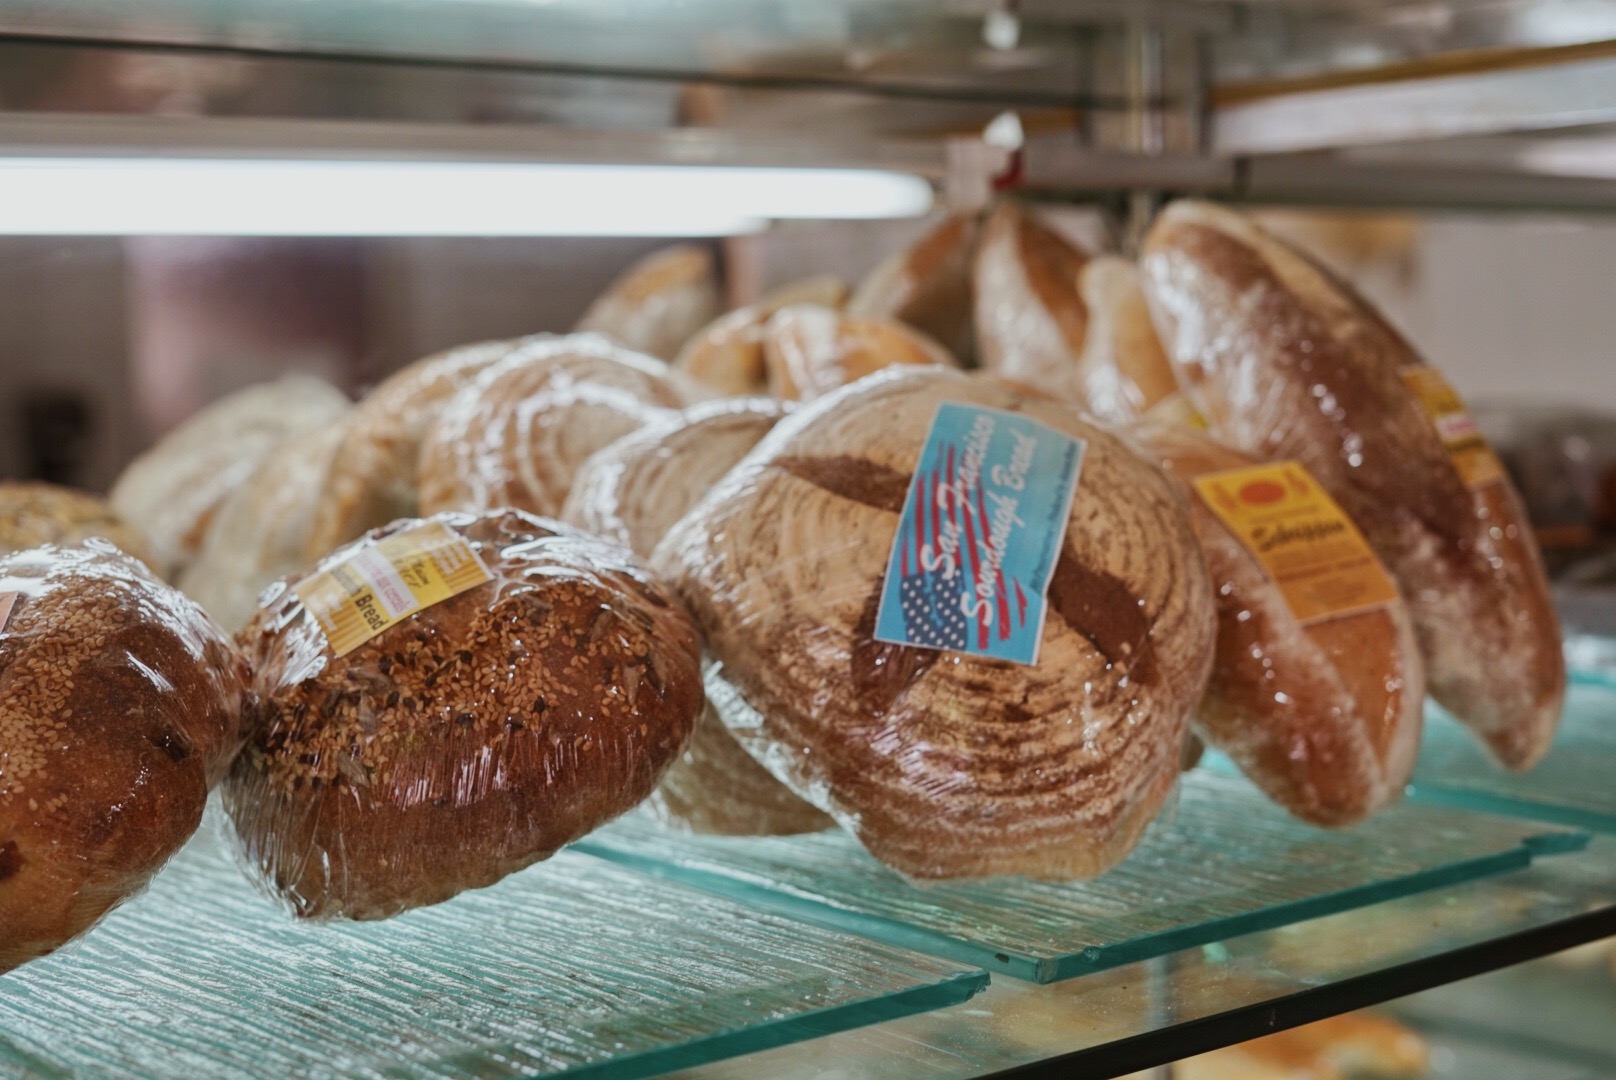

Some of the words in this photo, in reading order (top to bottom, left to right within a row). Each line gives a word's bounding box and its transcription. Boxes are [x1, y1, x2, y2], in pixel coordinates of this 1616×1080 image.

[935, 414, 996, 515] Francisco
[991, 429, 1037, 492] Bread
[919, 521, 962, 580] San
[960, 489, 1026, 627] Sourdough
[354, 593, 389, 630] Bread
